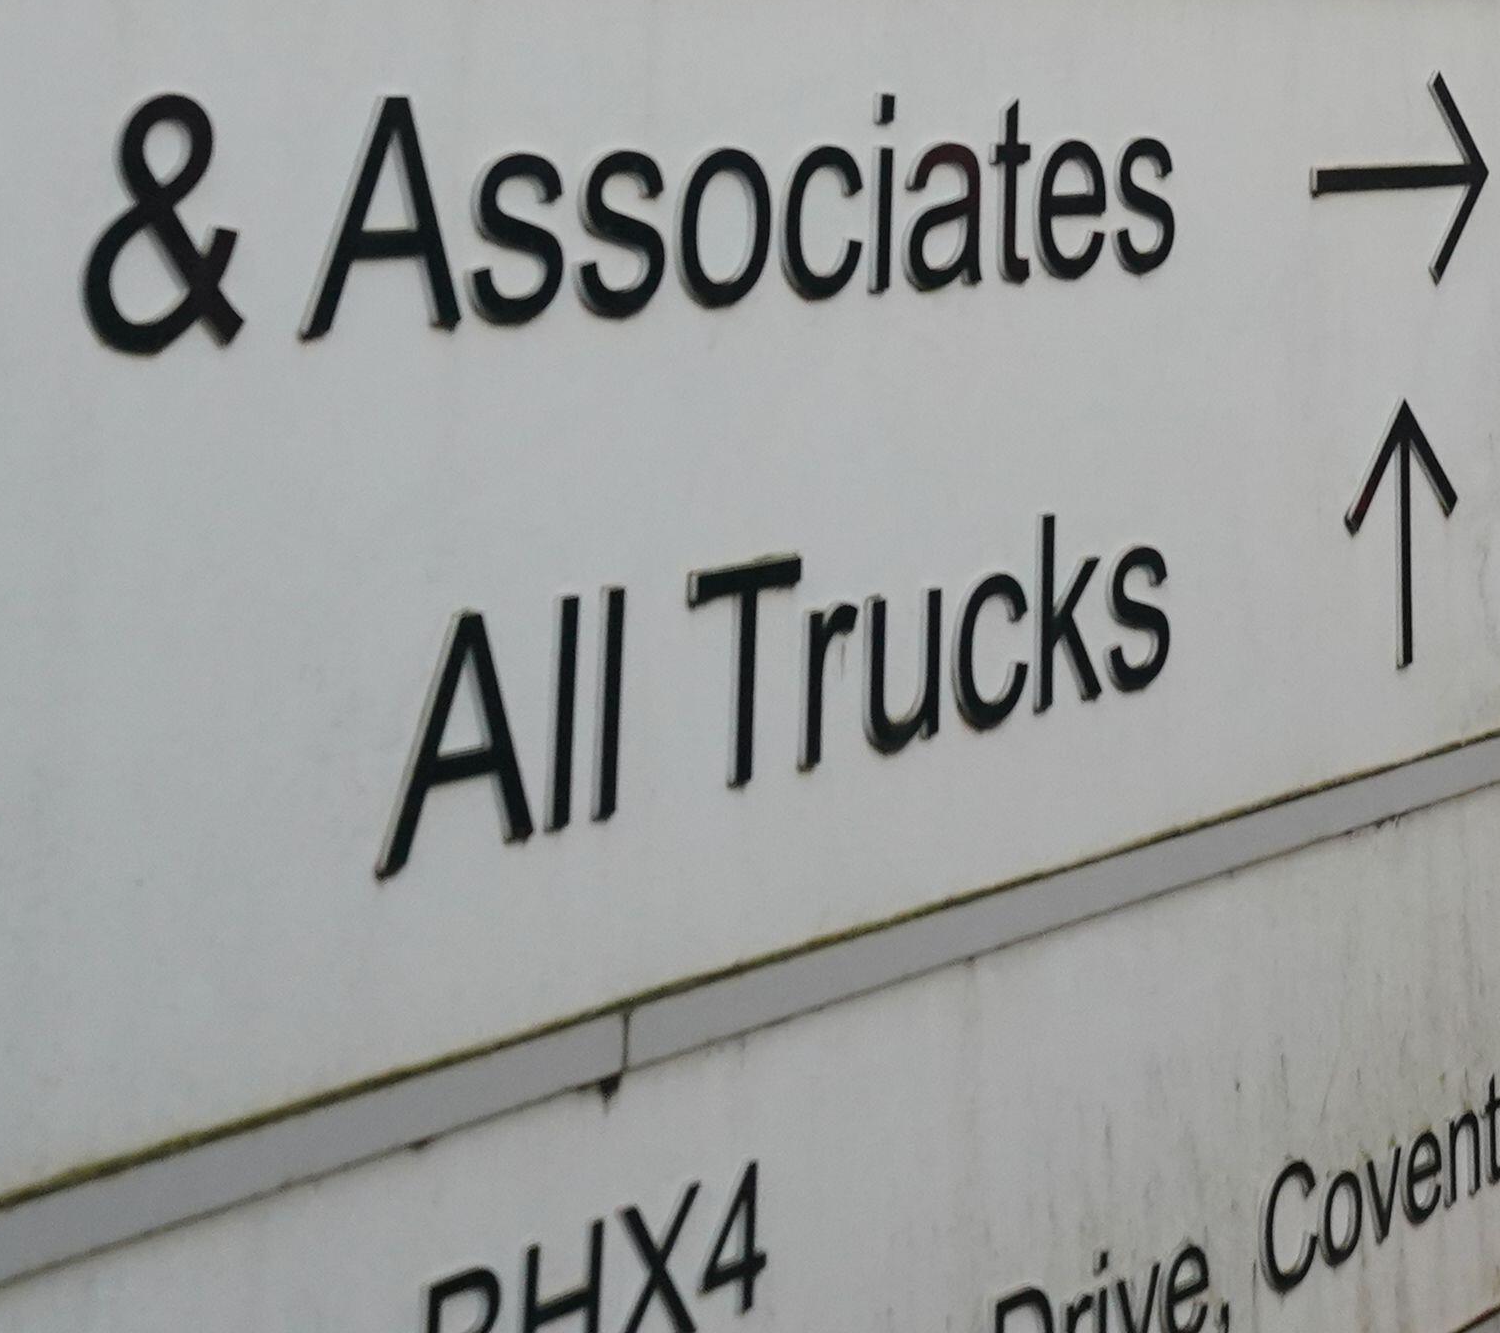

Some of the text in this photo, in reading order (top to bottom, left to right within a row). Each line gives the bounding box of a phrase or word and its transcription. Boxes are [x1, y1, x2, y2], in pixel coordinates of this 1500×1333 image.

[82, 92, 246, 356] &
[300, 92, 1176, 343] Associates
[374, 514, 1171, 881] All Trucks
